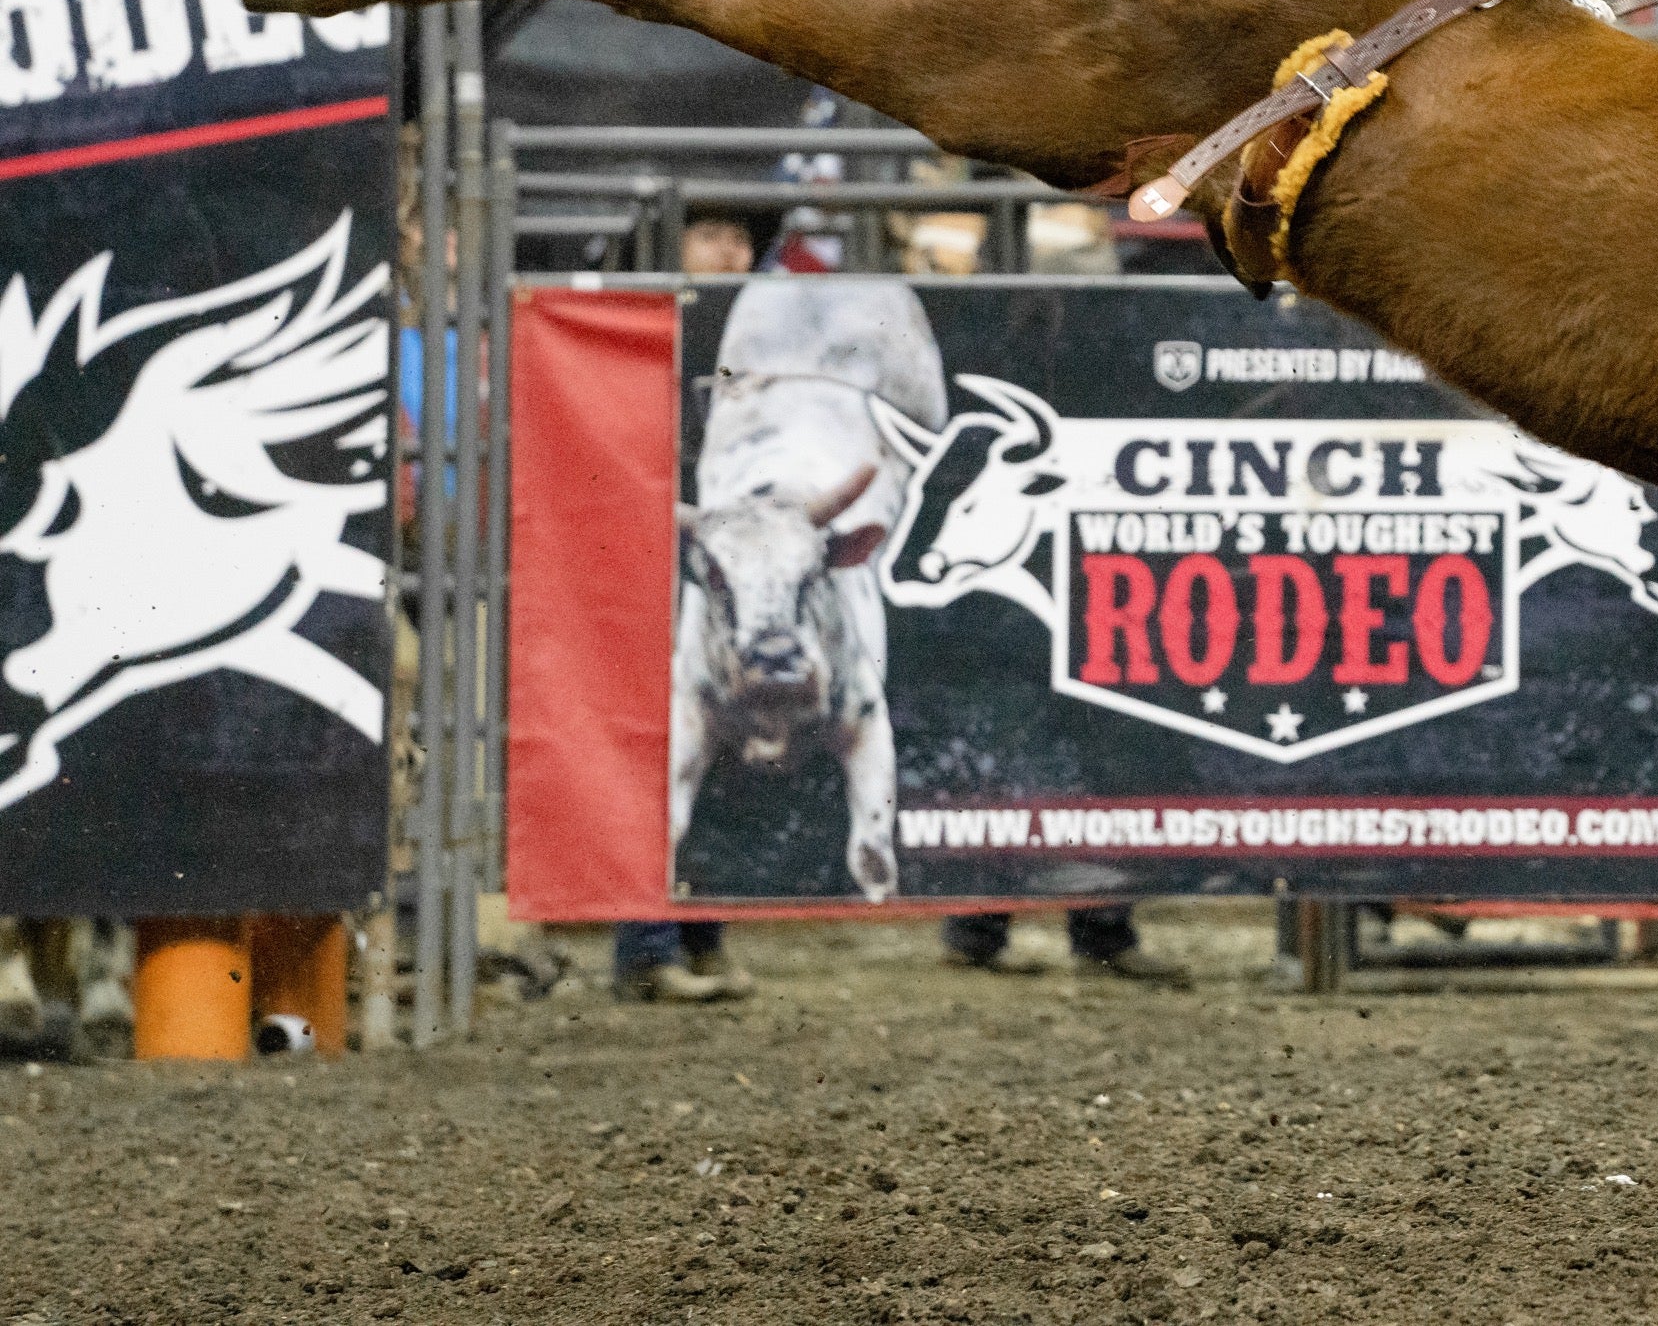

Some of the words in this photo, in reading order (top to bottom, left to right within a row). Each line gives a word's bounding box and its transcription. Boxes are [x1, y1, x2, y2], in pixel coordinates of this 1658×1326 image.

[1114, 439, 1445, 497] CINCH
[1076, 513, 1266, 554] WORLD'S
[1281, 513, 1500, 554] TOUGHEST
[1079, 552, 1494, 686] RODEO
